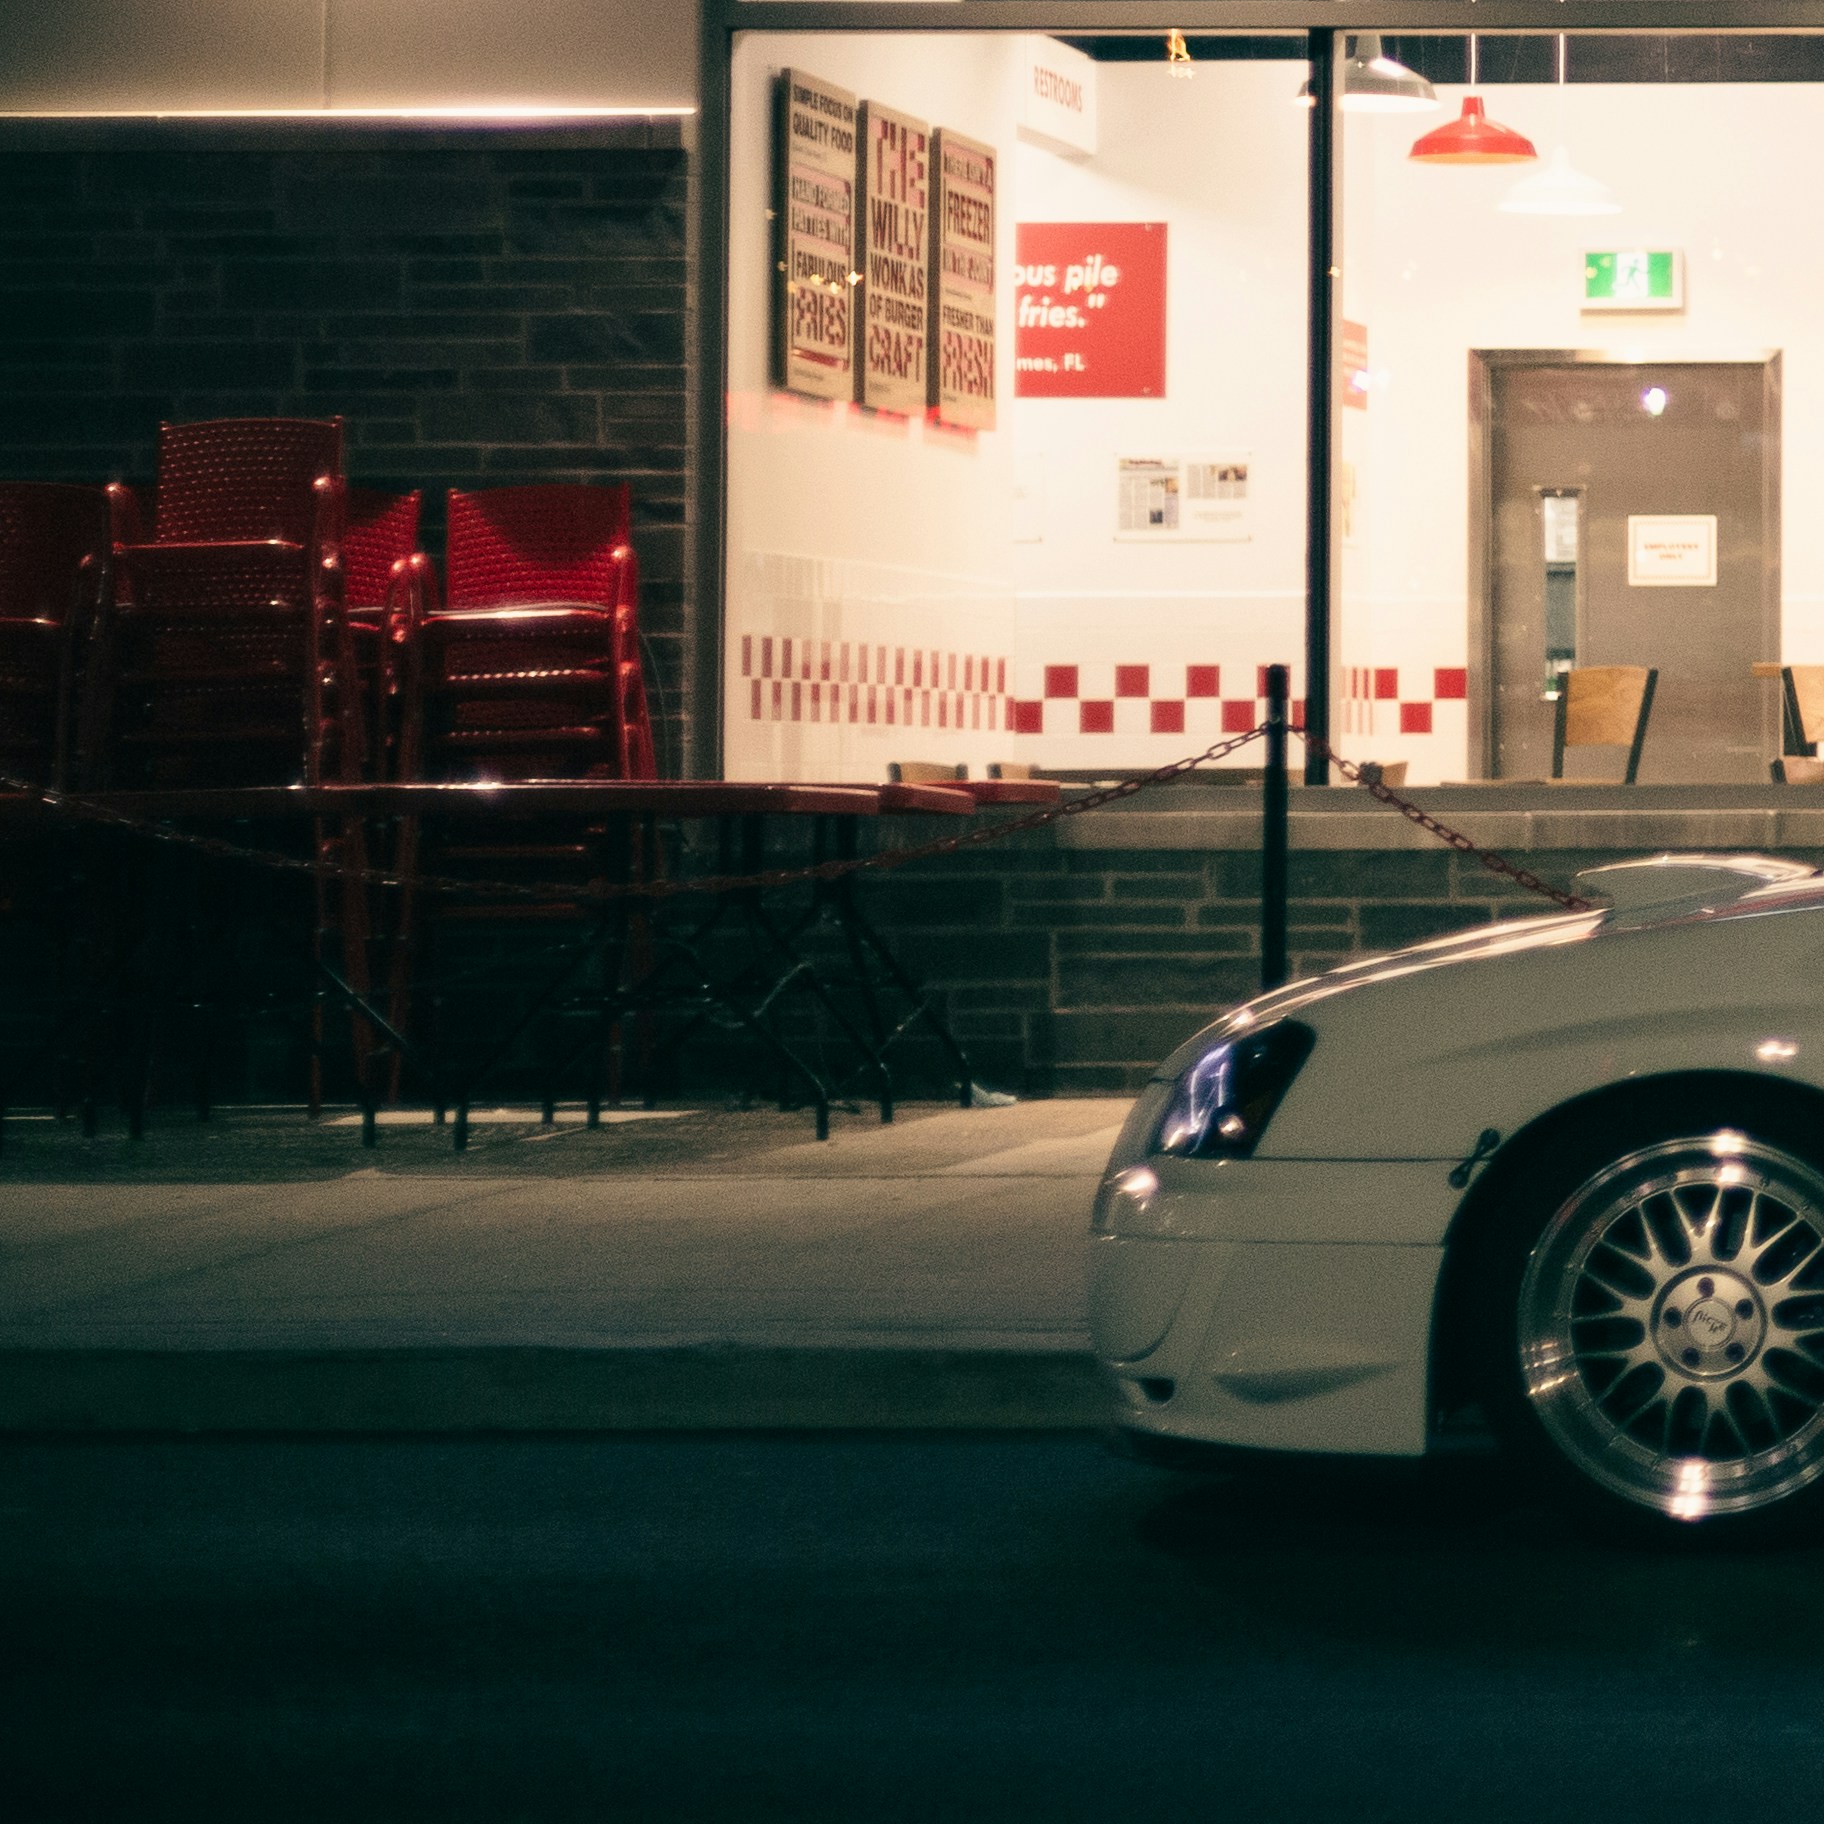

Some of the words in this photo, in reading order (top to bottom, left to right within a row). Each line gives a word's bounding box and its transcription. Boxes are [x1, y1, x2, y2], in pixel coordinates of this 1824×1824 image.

[1034, 65, 1083, 113] RESTROOMS
[793, 113, 830, 149] QUALITY
[831, 121, 853, 153] FOOD
[871, 195, 925, 262] WILLY
[948, 190, 990, 246] FREEZER
[796, 251, 846, 289] FABULOUS
[870, 252, 925, 301] WONKAS
[1064, 253, 1118, 295] pile
[795, 286, 847, 347] FRIES
[869, 293, 883, 319] OF
[884, 297, 924, 332] BURGER
[943, 304, 974, 330] FRESHER
[975, 314, 994, 336] THAN
[869, 323, 924, 383] CRAFT
[942, 330, 994, 400] FRESH
[1064, 352, 1085, 371] FL
